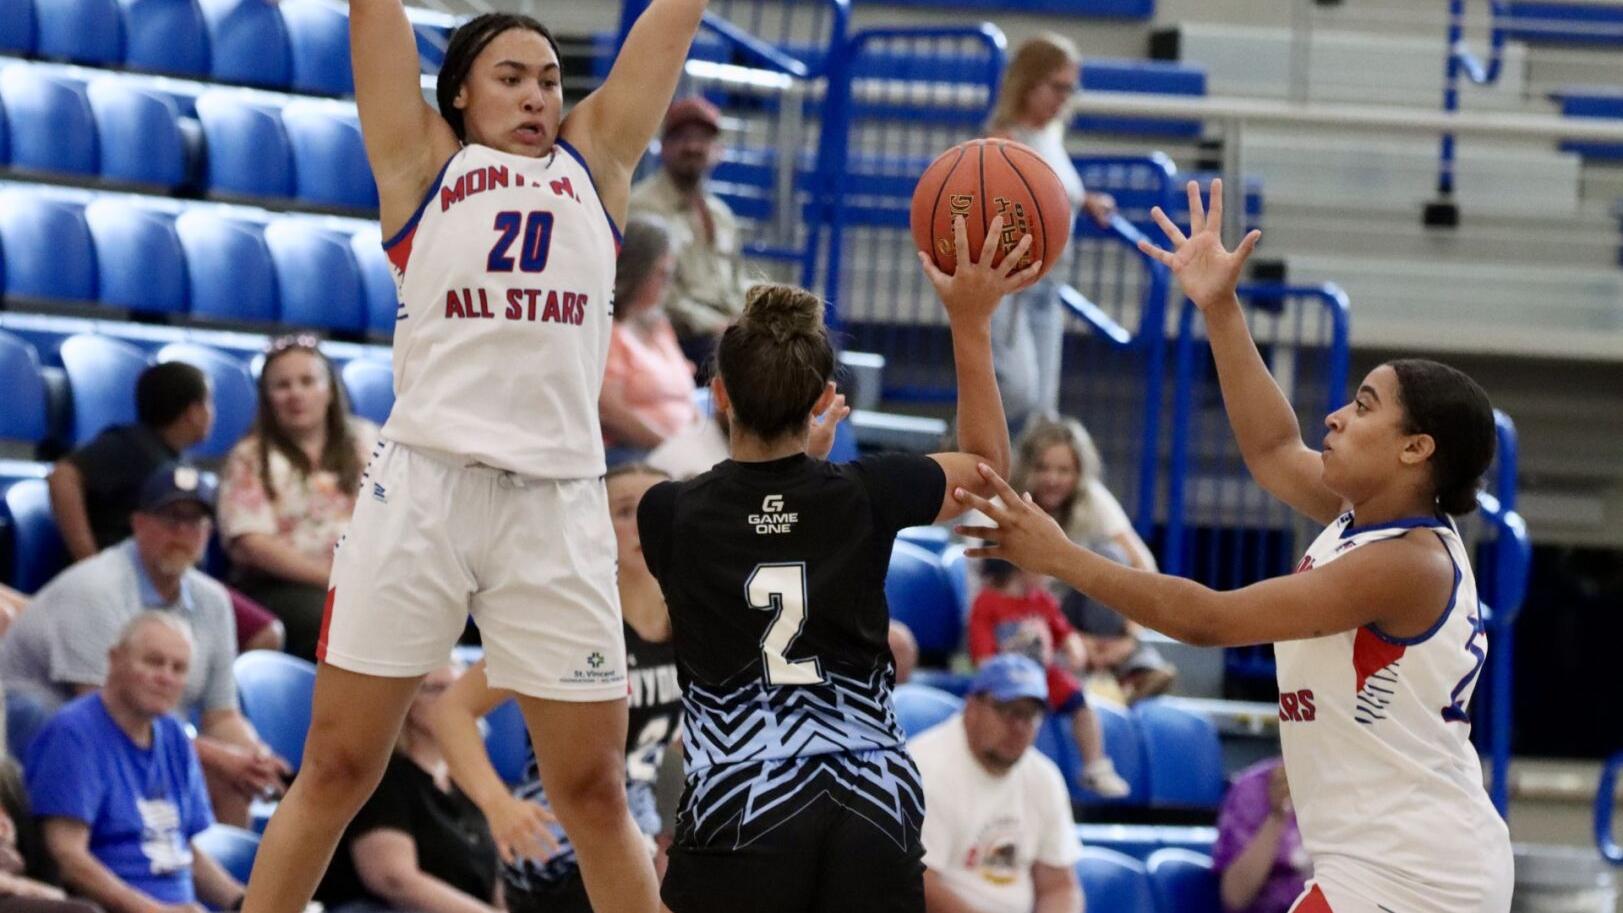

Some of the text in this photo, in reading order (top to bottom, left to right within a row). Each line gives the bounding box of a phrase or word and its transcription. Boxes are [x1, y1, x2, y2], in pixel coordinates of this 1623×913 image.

[486, 210, 554, 273] 20
[445, 287, 588, 326] ALL STARS
[748, 513, 799, 524] GAME
[756, 524, 791, 534] ONE
[744, 561, 826, 688] 2
